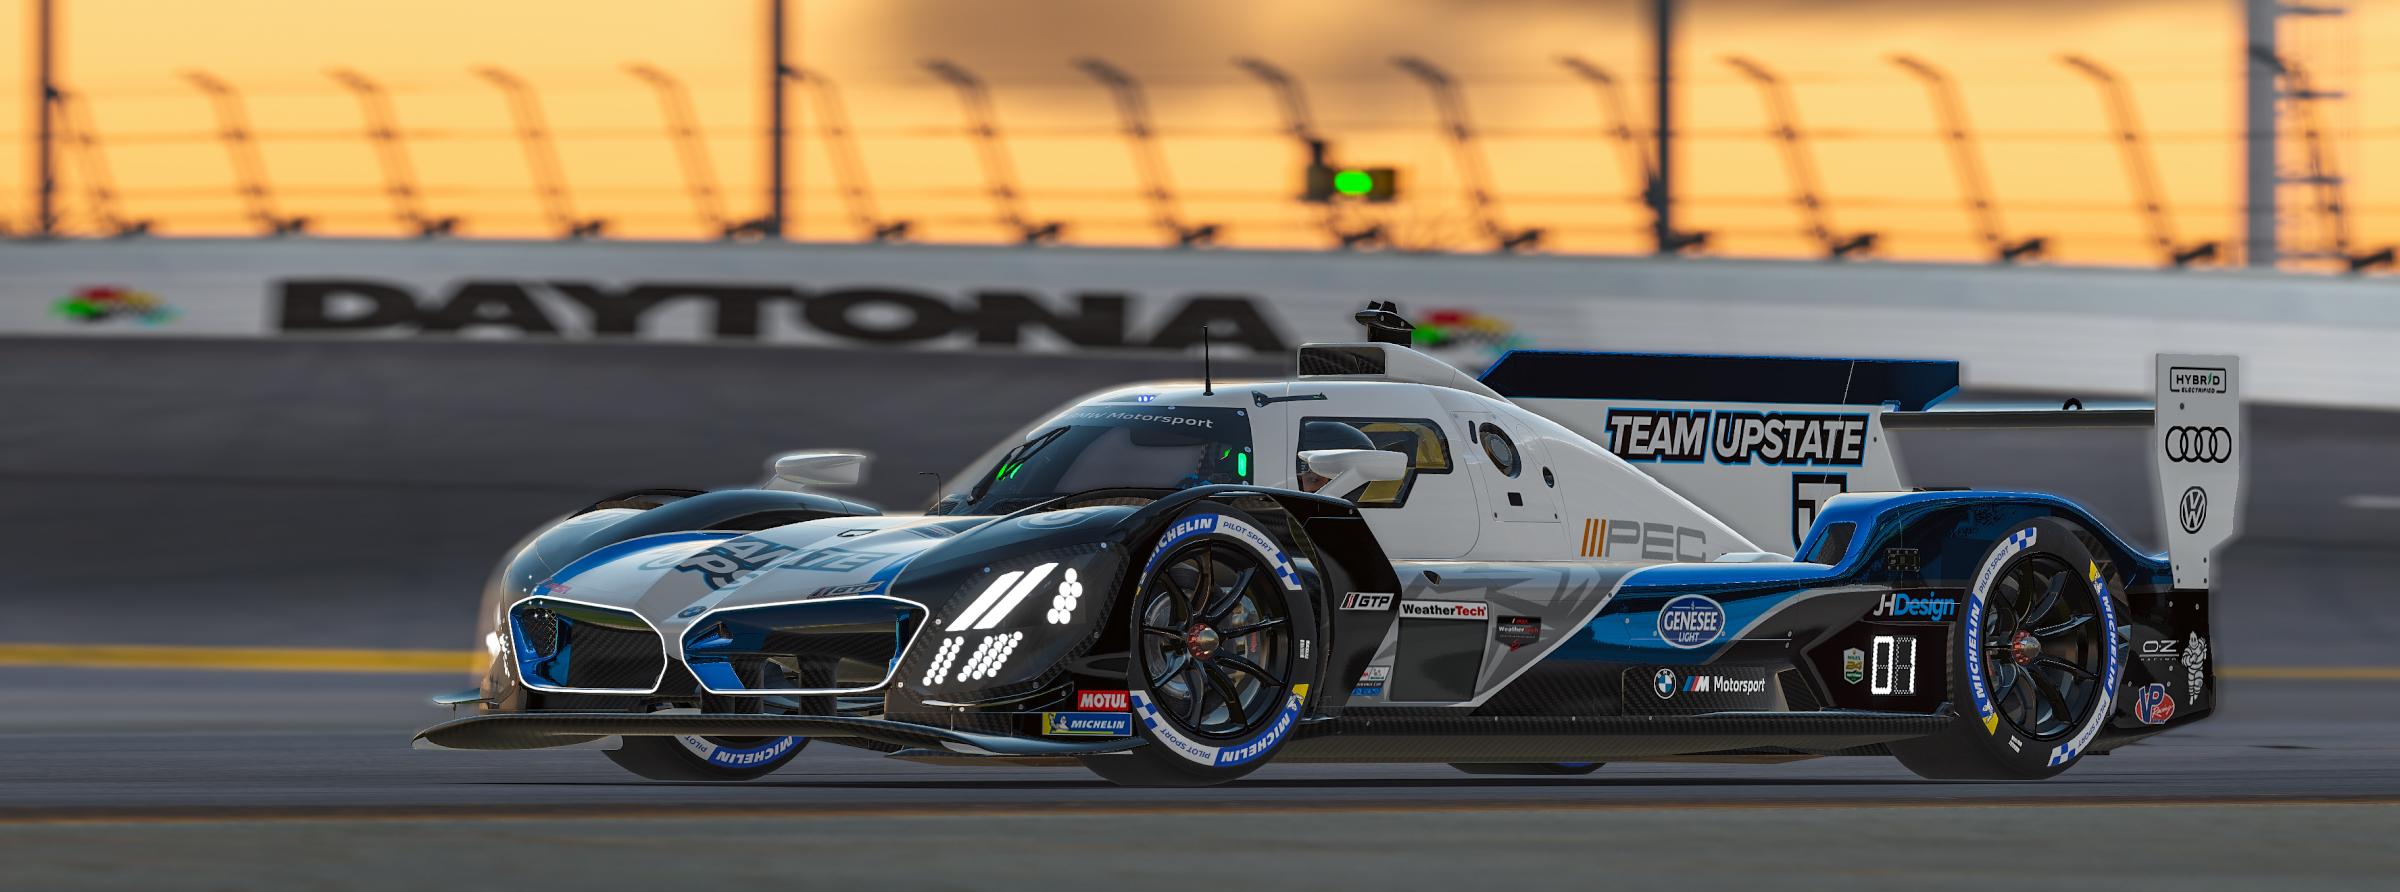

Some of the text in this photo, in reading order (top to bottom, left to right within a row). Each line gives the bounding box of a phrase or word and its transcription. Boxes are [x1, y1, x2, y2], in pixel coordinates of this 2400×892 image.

[276, 278, 1296, 352] DAYTONA
[1107, 412, 1214, 429] Motorsport
[1609, 414, 1865, 460] TEAM UPSTATE
[1223, 521, 1274, 553] PILOT SPORT
[1605, 519, 1706, 563] PEC
[1978, 546, 2010, 594] PILOT SPORT
[1358, 595, 1390, 608] GTP
[1402, 604, 1486, 617] WeatherTech
[1663, 610, 1718, 632] GENESEE
[1678, 632, 1700, 643] LIGHT
[1969, 601, 1986, 699] MICHELIN
[2101, 596, 2118, 692] MICHELIN
[1871, 636, 1917, 695] 01
[1080, 692, 1127, 709] MOTUL
[1713, 675, 1766, 695] Motorsport
[2139, 684, 2165, 724] VP
[1070, 719, 1126, 730] MICHELIN
[1220, 711, 1291, 763] MICHELIN
[2078, 700, 2108, 748] PILOT SPORT
[715, 735, 793, 764] MICHELIN
[1159, 728, 1211, 760] PILOT SPORT
